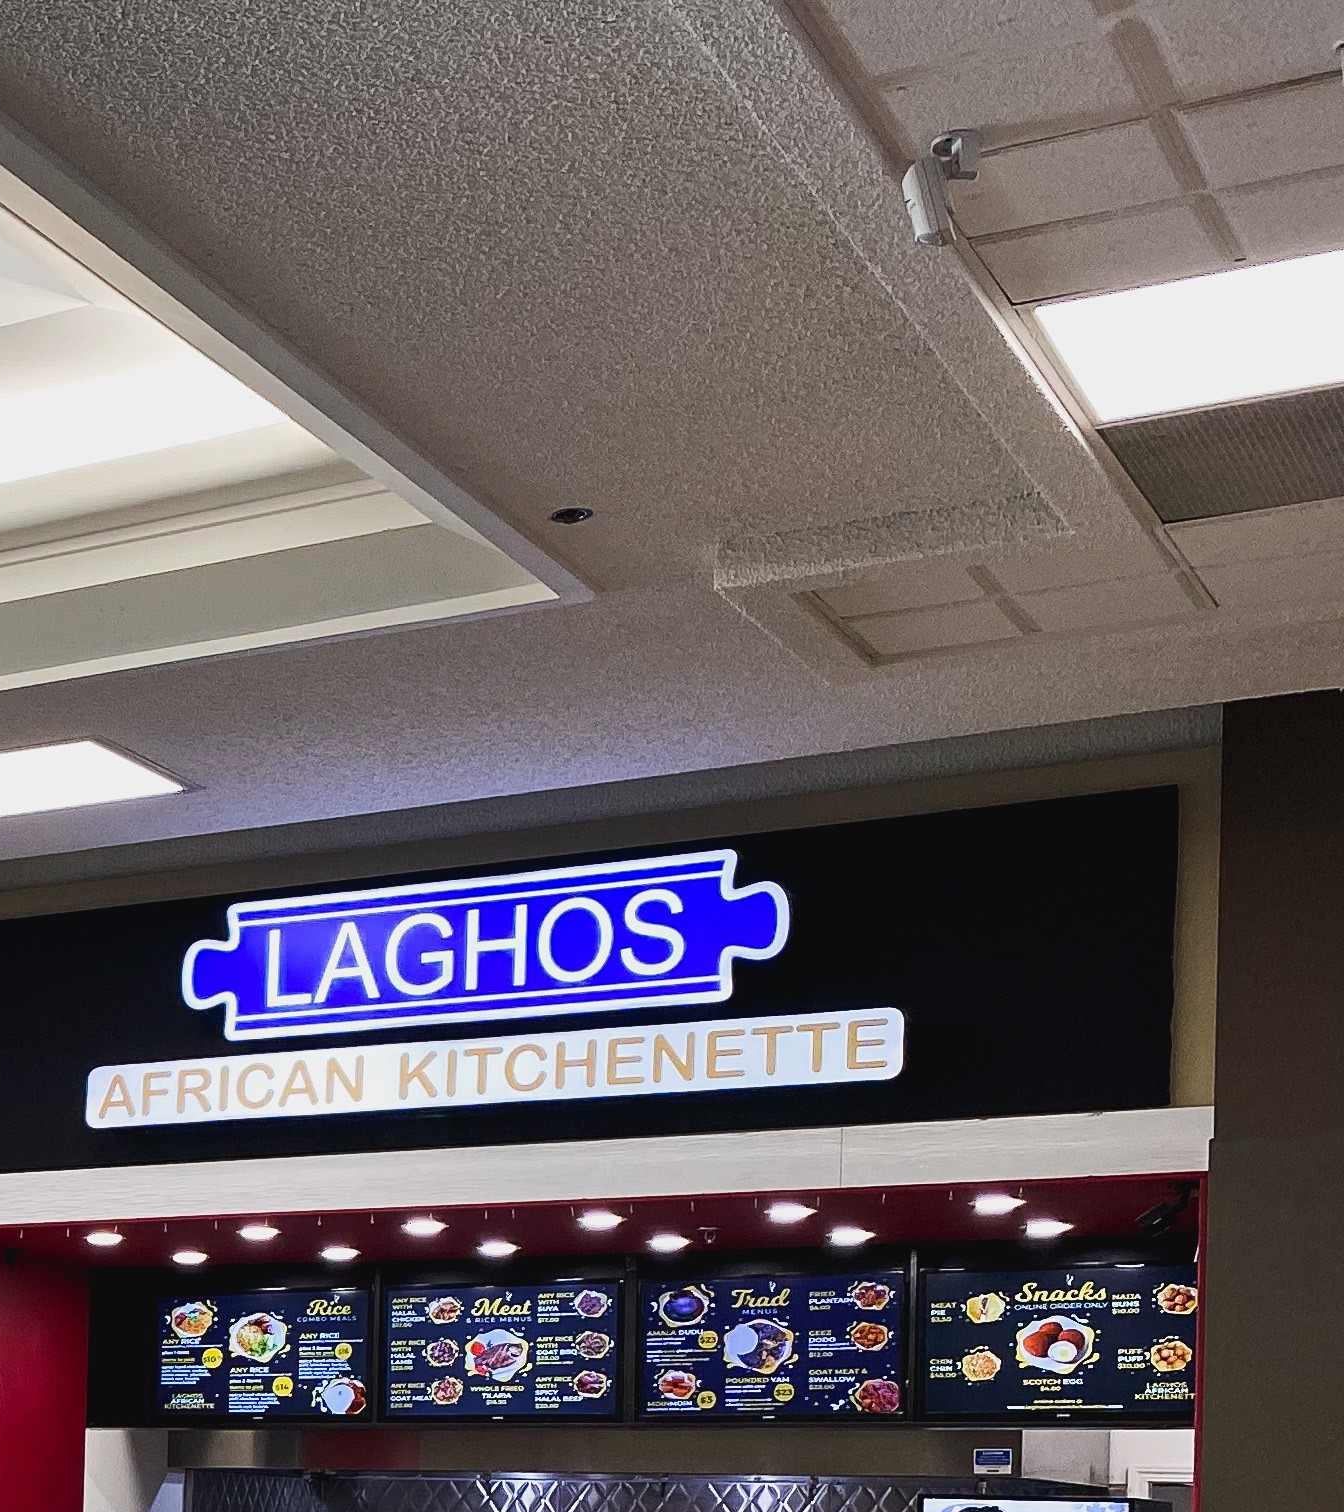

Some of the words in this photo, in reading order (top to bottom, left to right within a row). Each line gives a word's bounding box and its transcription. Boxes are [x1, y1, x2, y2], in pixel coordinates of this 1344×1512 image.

[264, 889, 687, 1009] LAGHOS
[97, 1054, 363, 1120] AFRICAN
[397, 1017, 889, 1100] KITCHENETTE
[731, 1288, 790, 1308] Trad
[1015, 1282, 1106, 1302] Snacks
[307, 1299, 351, 1315] Rice
[471, 1298, 532, 1316] Meat
